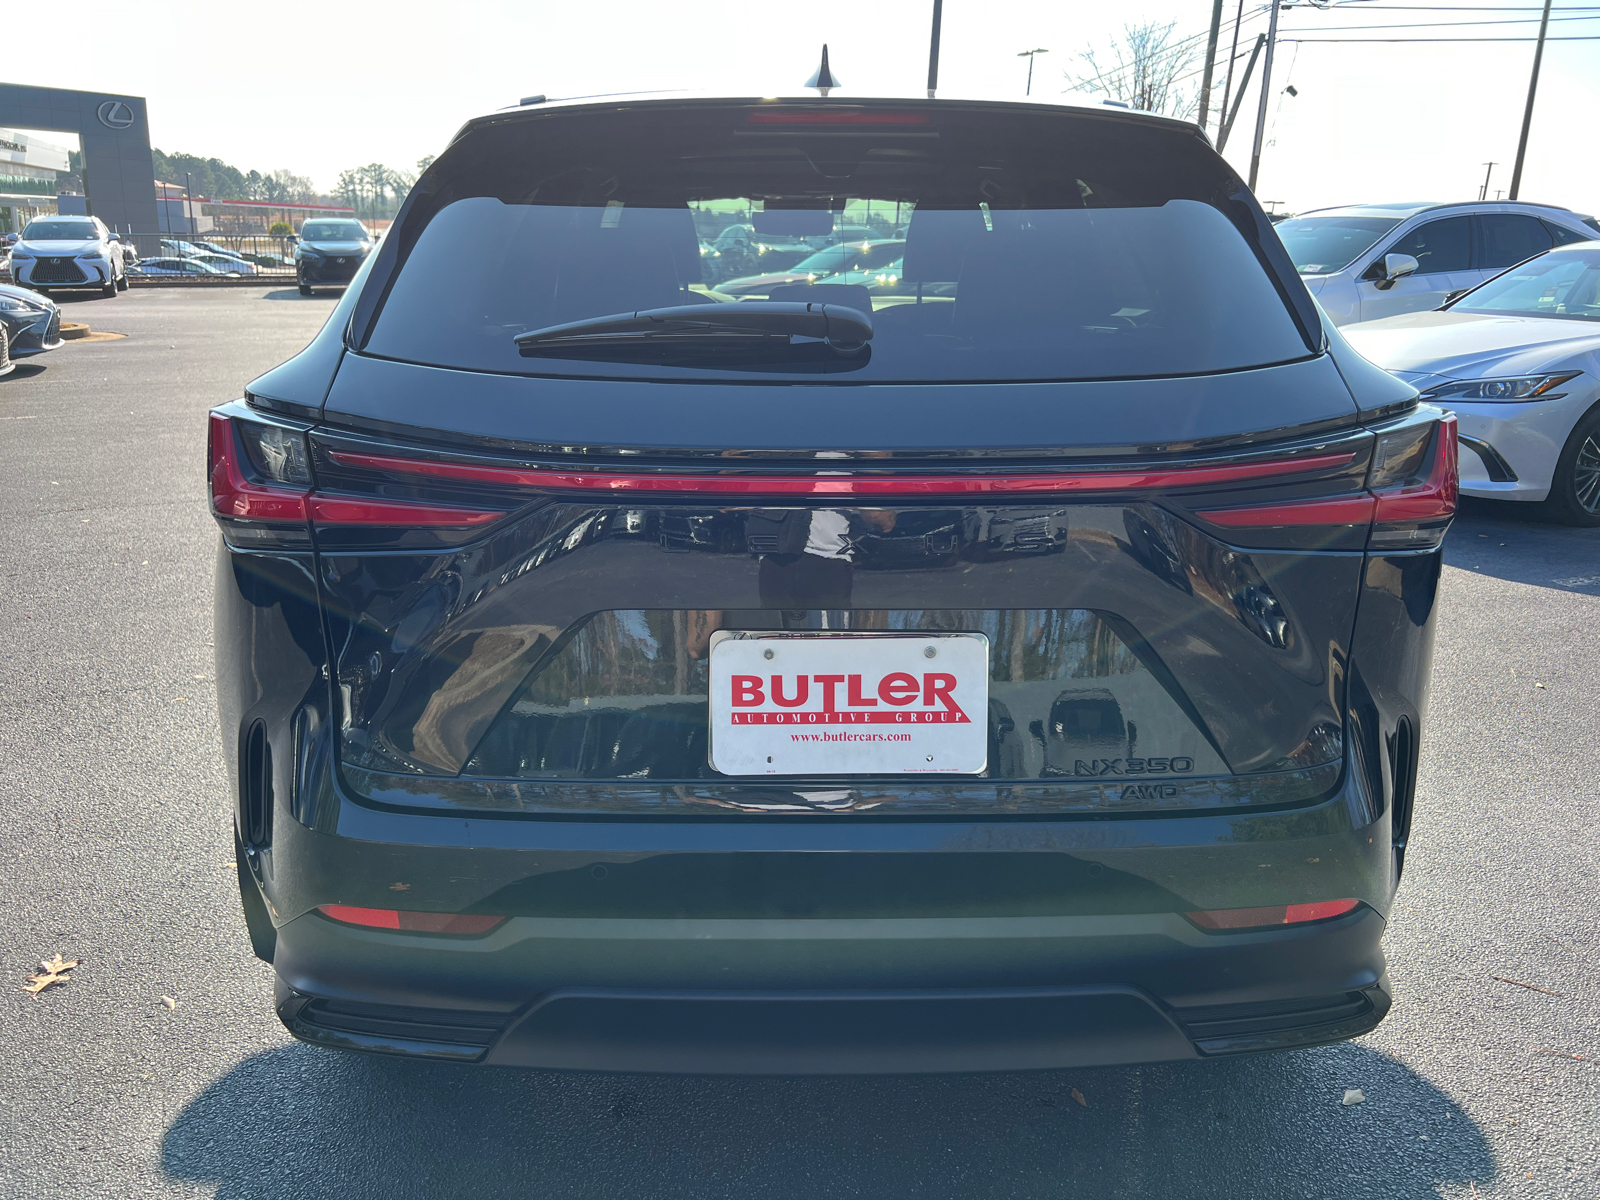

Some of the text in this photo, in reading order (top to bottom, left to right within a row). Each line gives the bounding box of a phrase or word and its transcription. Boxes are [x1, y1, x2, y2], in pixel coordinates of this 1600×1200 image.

[660, 533, 1048, 554] LEXUS
[733, 712, 962, 723] AUTOMOTIVE GROUP
[791, 731, 912, 742] www.butlercars.com
[1120, 785, 1181, 800] AWD
